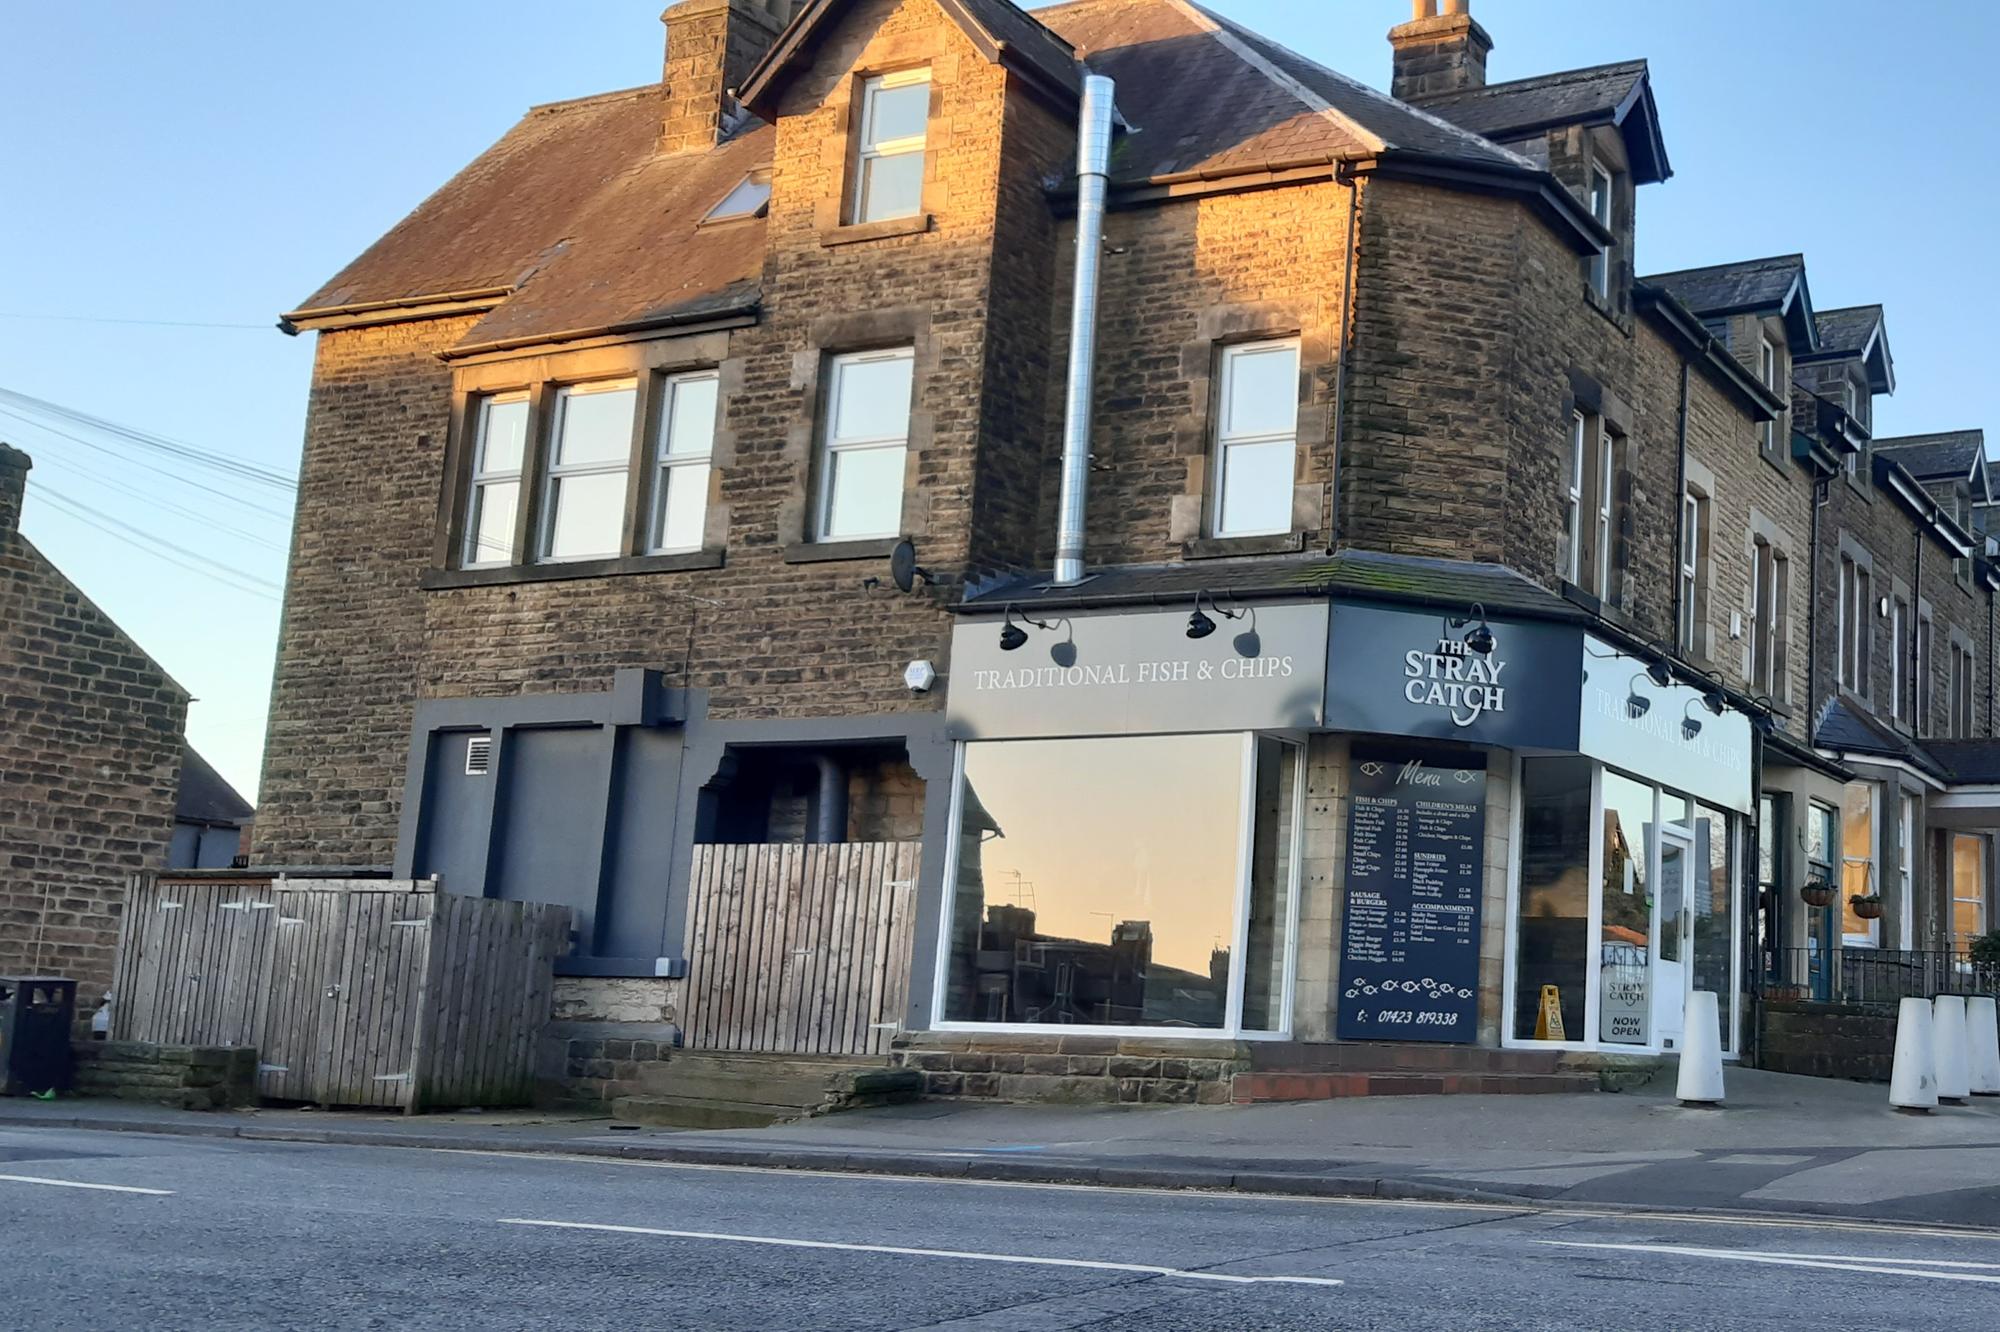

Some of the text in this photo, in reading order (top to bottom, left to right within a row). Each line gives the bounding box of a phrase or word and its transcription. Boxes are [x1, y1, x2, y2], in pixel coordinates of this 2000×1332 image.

[1439, 640, 1473, 656] THE
[975, 656, 1293, 690] TRADITIONAL FISH & CHIPS
[1405, 650, 1506, 684] STRAY
[1405, 679, 1504, 726] CATCH
[1596, 688, 1741, 772] TRADITIONAL FISH & CHIPS
[1396, 760, 1441, 786] Menu
[1414, 852, 1447, 860] SUNDRIES
[1412, 903, 1474, 912] ACCOMPANIMENTS
[1610, 992, 1644, 1006] CATCH
[1357, 1010, 1458, 1025] t: 01423 819338
[1613, 1017, 1640, 1026] NOW
[1612, 1027, 1641, 1036] OPEN
